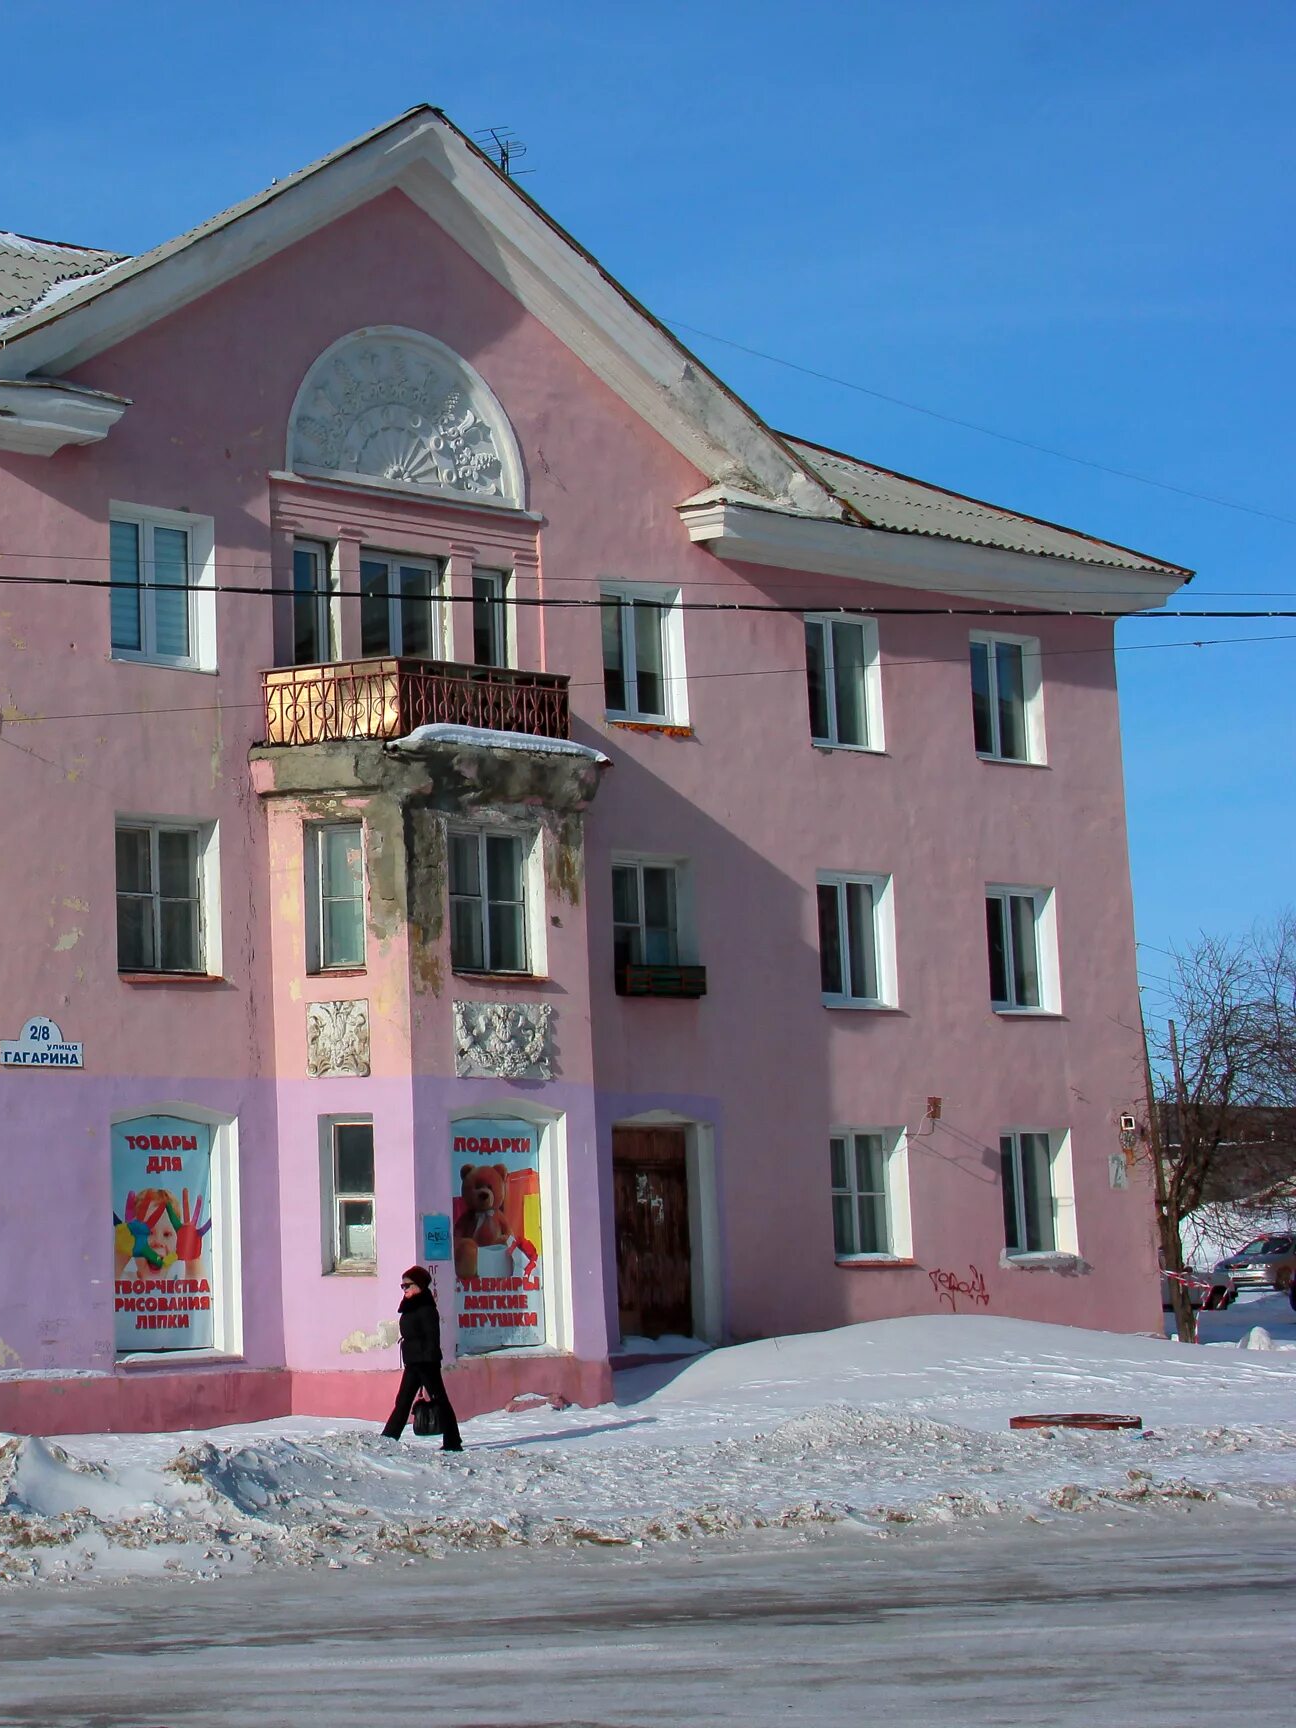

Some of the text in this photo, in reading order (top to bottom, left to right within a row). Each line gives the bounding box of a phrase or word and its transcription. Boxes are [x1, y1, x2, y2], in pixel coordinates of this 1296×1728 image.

[30, 1025, 50, 1041] 2/8
[4, 1052, 79, 1064] ГАГАРИНА
[125, 1134, 197, 1150] ТОВАРЫ
[454, 1136, 531, 1155] ПОДАРКИ
[146, 1156, 183, 1174] ДЛЯ
[114, 1279, 211, 1294] ТВОРЧЕСТВА
[115, 1296, 211, 1312] РИСОВАНИЯ
[464, 1294, 529, 1310] МЯГКИЕ
[136, 1314, 190, 1329] ЛЕПКИ
[458, 1312, 538, 1328] ИГРУШКИ
